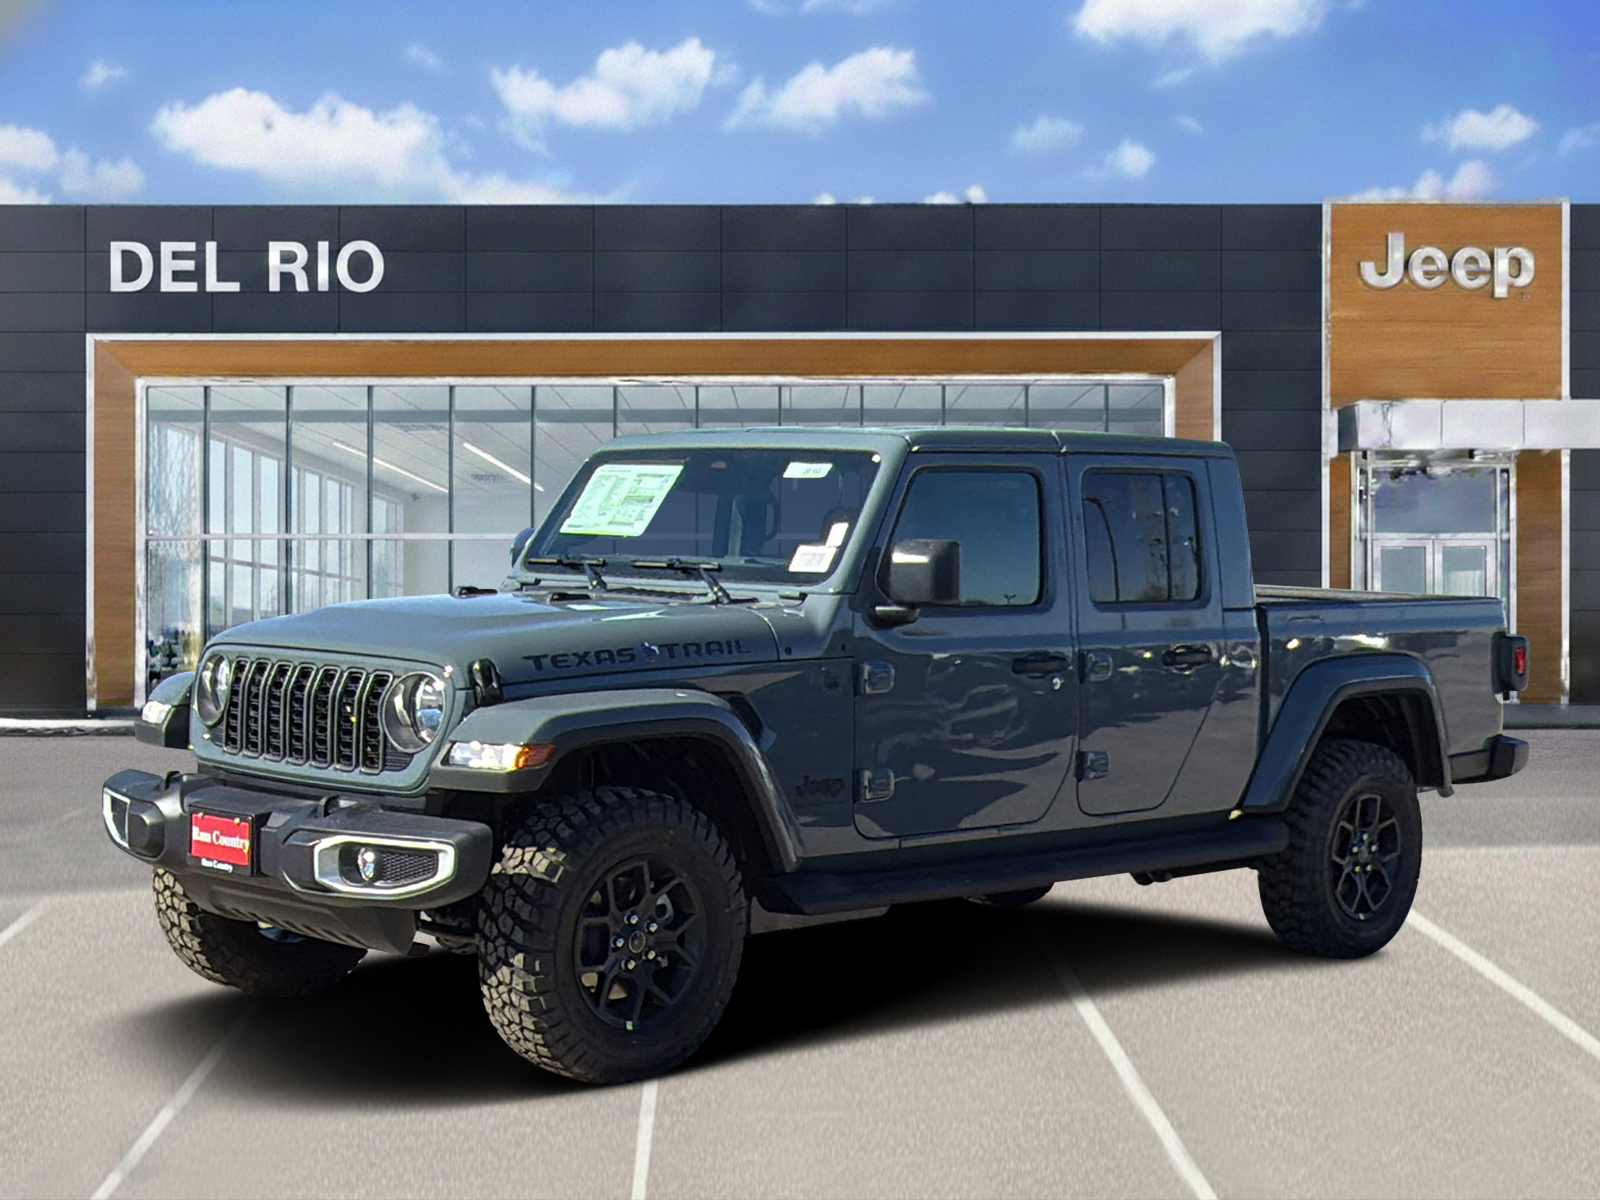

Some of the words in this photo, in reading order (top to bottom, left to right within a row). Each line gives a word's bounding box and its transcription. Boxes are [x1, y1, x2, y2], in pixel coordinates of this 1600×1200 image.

[110, 241, 241, 292] DEL
[268, 240, 385, 293] RIO
[1360, 232, 1535, 298] Jeep
[523, 646, 636, 671] TEXAS
[657, 639, 752, 660] TRAIL
[796, 775, 846, 798] Jeep
[192, 826, 212, 843] Ram
[212, 830, 250, 854] Country
